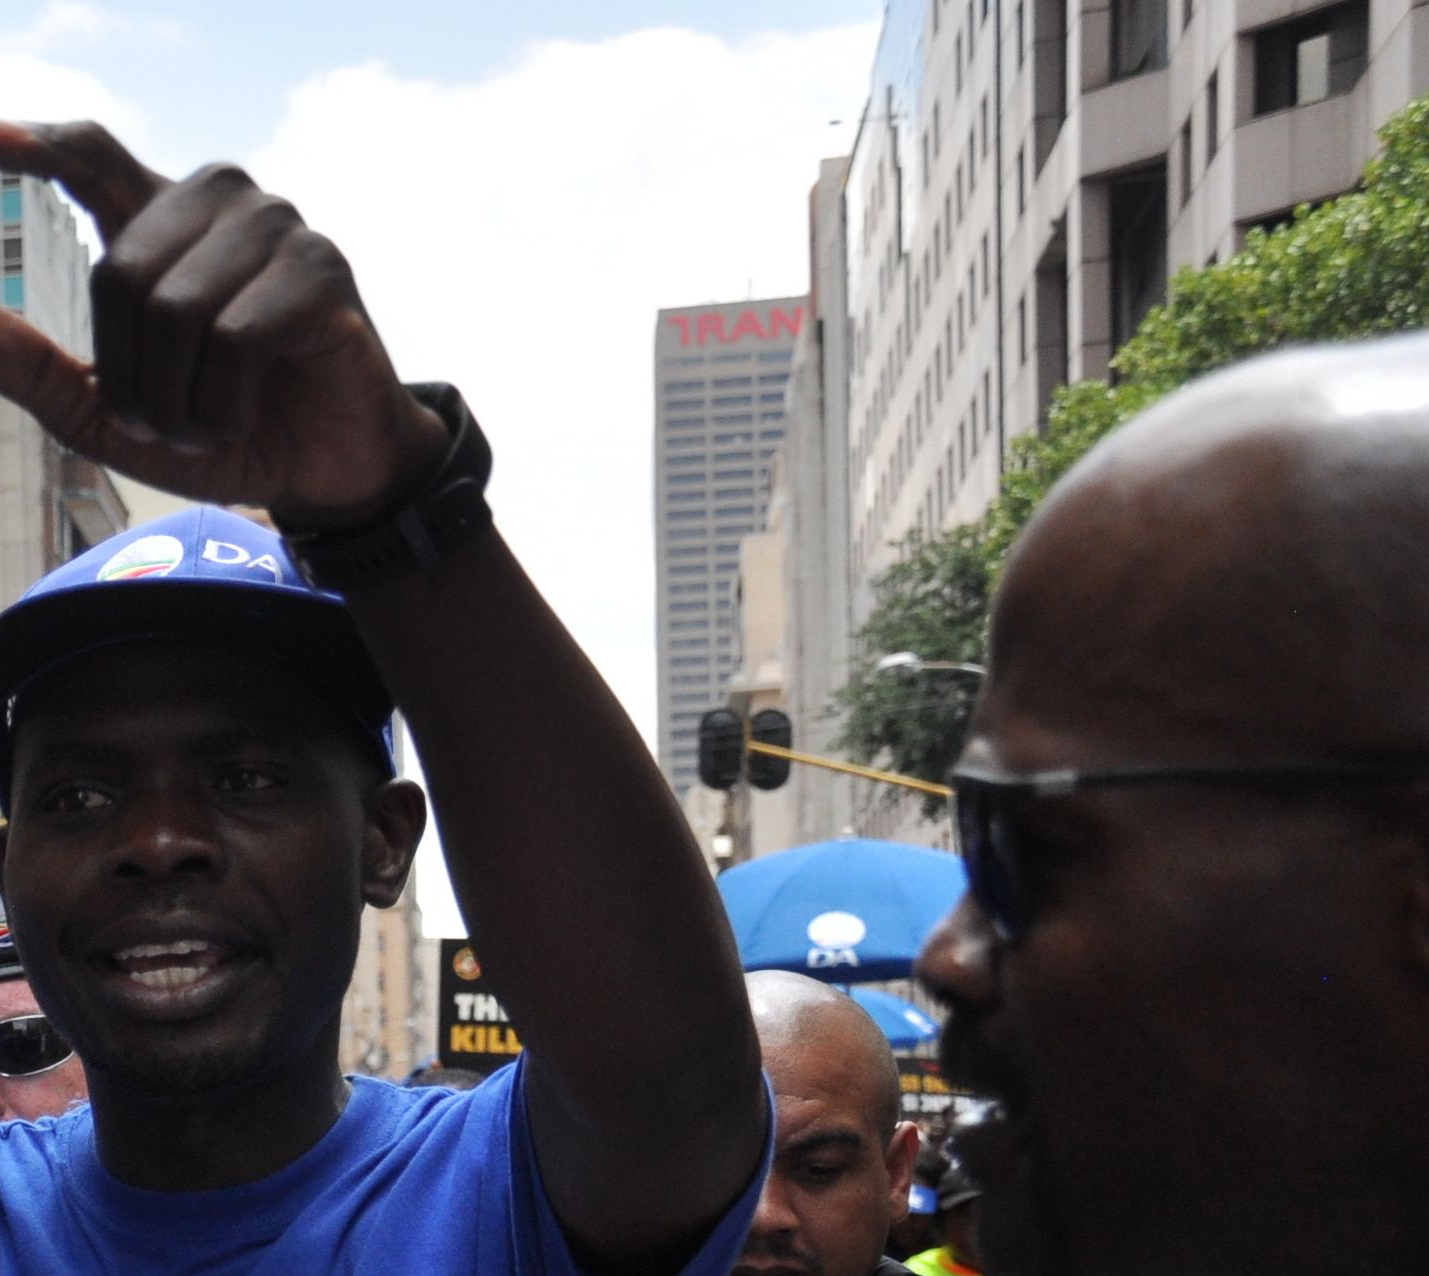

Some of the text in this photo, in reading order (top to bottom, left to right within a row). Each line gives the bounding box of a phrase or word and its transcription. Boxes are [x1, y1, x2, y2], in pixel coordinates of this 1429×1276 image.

[202, 538, 284, 584] DA
[807, 947, 859, 969] DA
[454, 992, 509, 1021] TH
